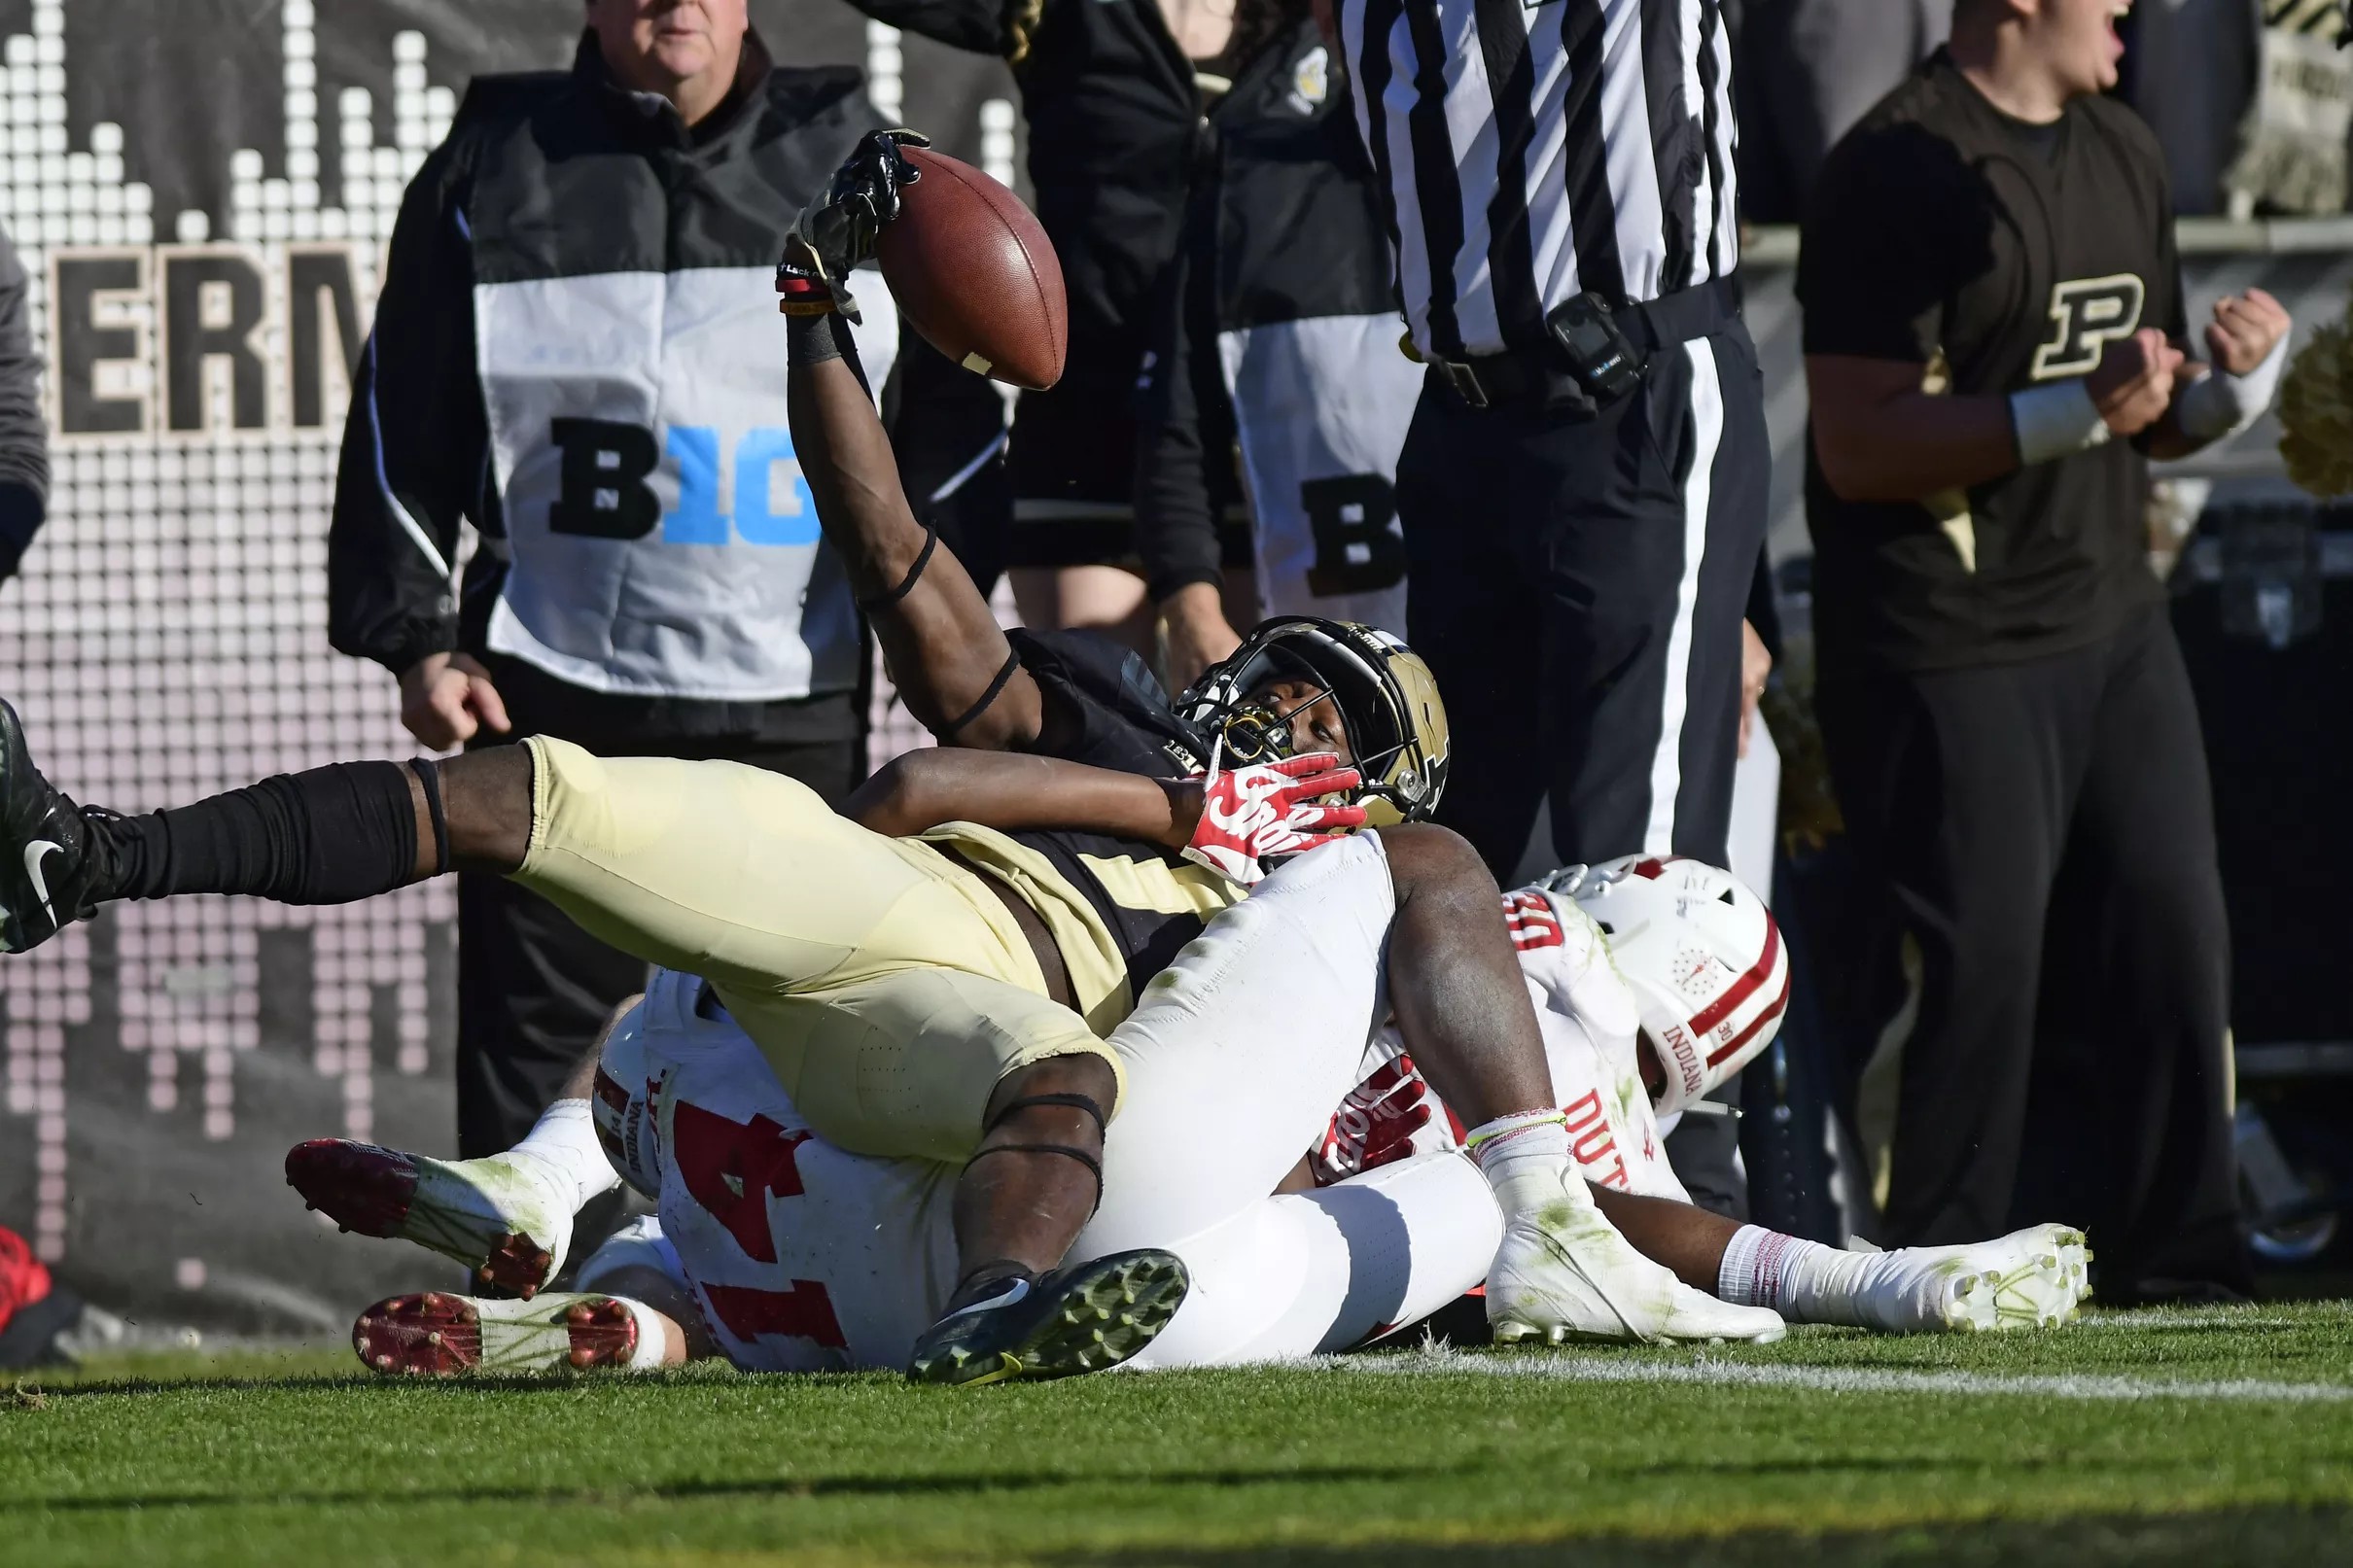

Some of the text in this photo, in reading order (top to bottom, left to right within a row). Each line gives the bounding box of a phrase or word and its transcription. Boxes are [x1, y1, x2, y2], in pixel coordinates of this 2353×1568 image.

[2030, 272, 2145, 381] P
[549, 416, 823, 546] B1G
[1663, 1024, 1703, 1098] INDIANA
[1716, 1021, 1735, 1042] 30
[625, 1100, 646, 1174] INDIANA
[1563, 1087, 1633, 1194] DUT
[673, 1098, 850, 1351] 14
